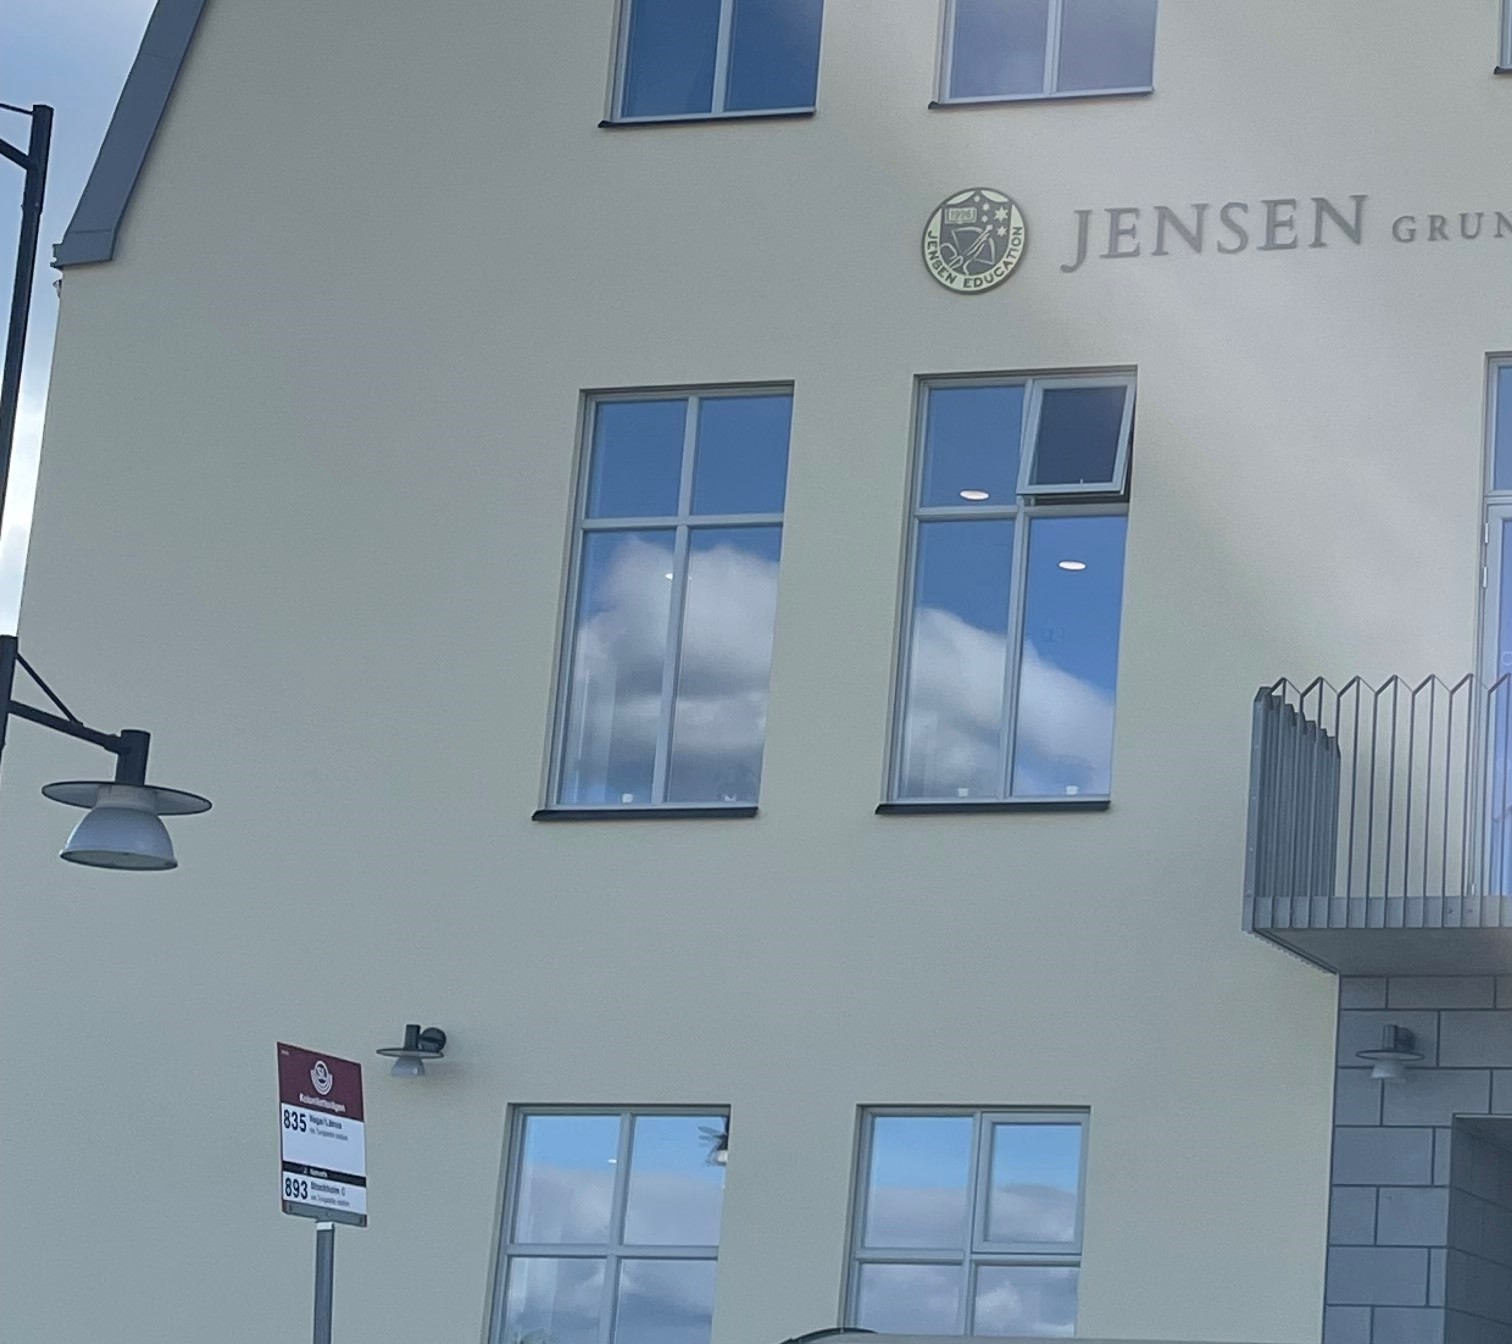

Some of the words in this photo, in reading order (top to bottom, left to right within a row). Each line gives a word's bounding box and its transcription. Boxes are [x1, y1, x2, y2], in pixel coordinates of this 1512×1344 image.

[1060, 194, 1368, 273] JENSEN
[927, 230, 958, 285] JENSEN
[962, 226, 1023, 289] EDUCATION
[283, 1109, 307, 1133] 835
[285, 1177, 308, 1200] 893
